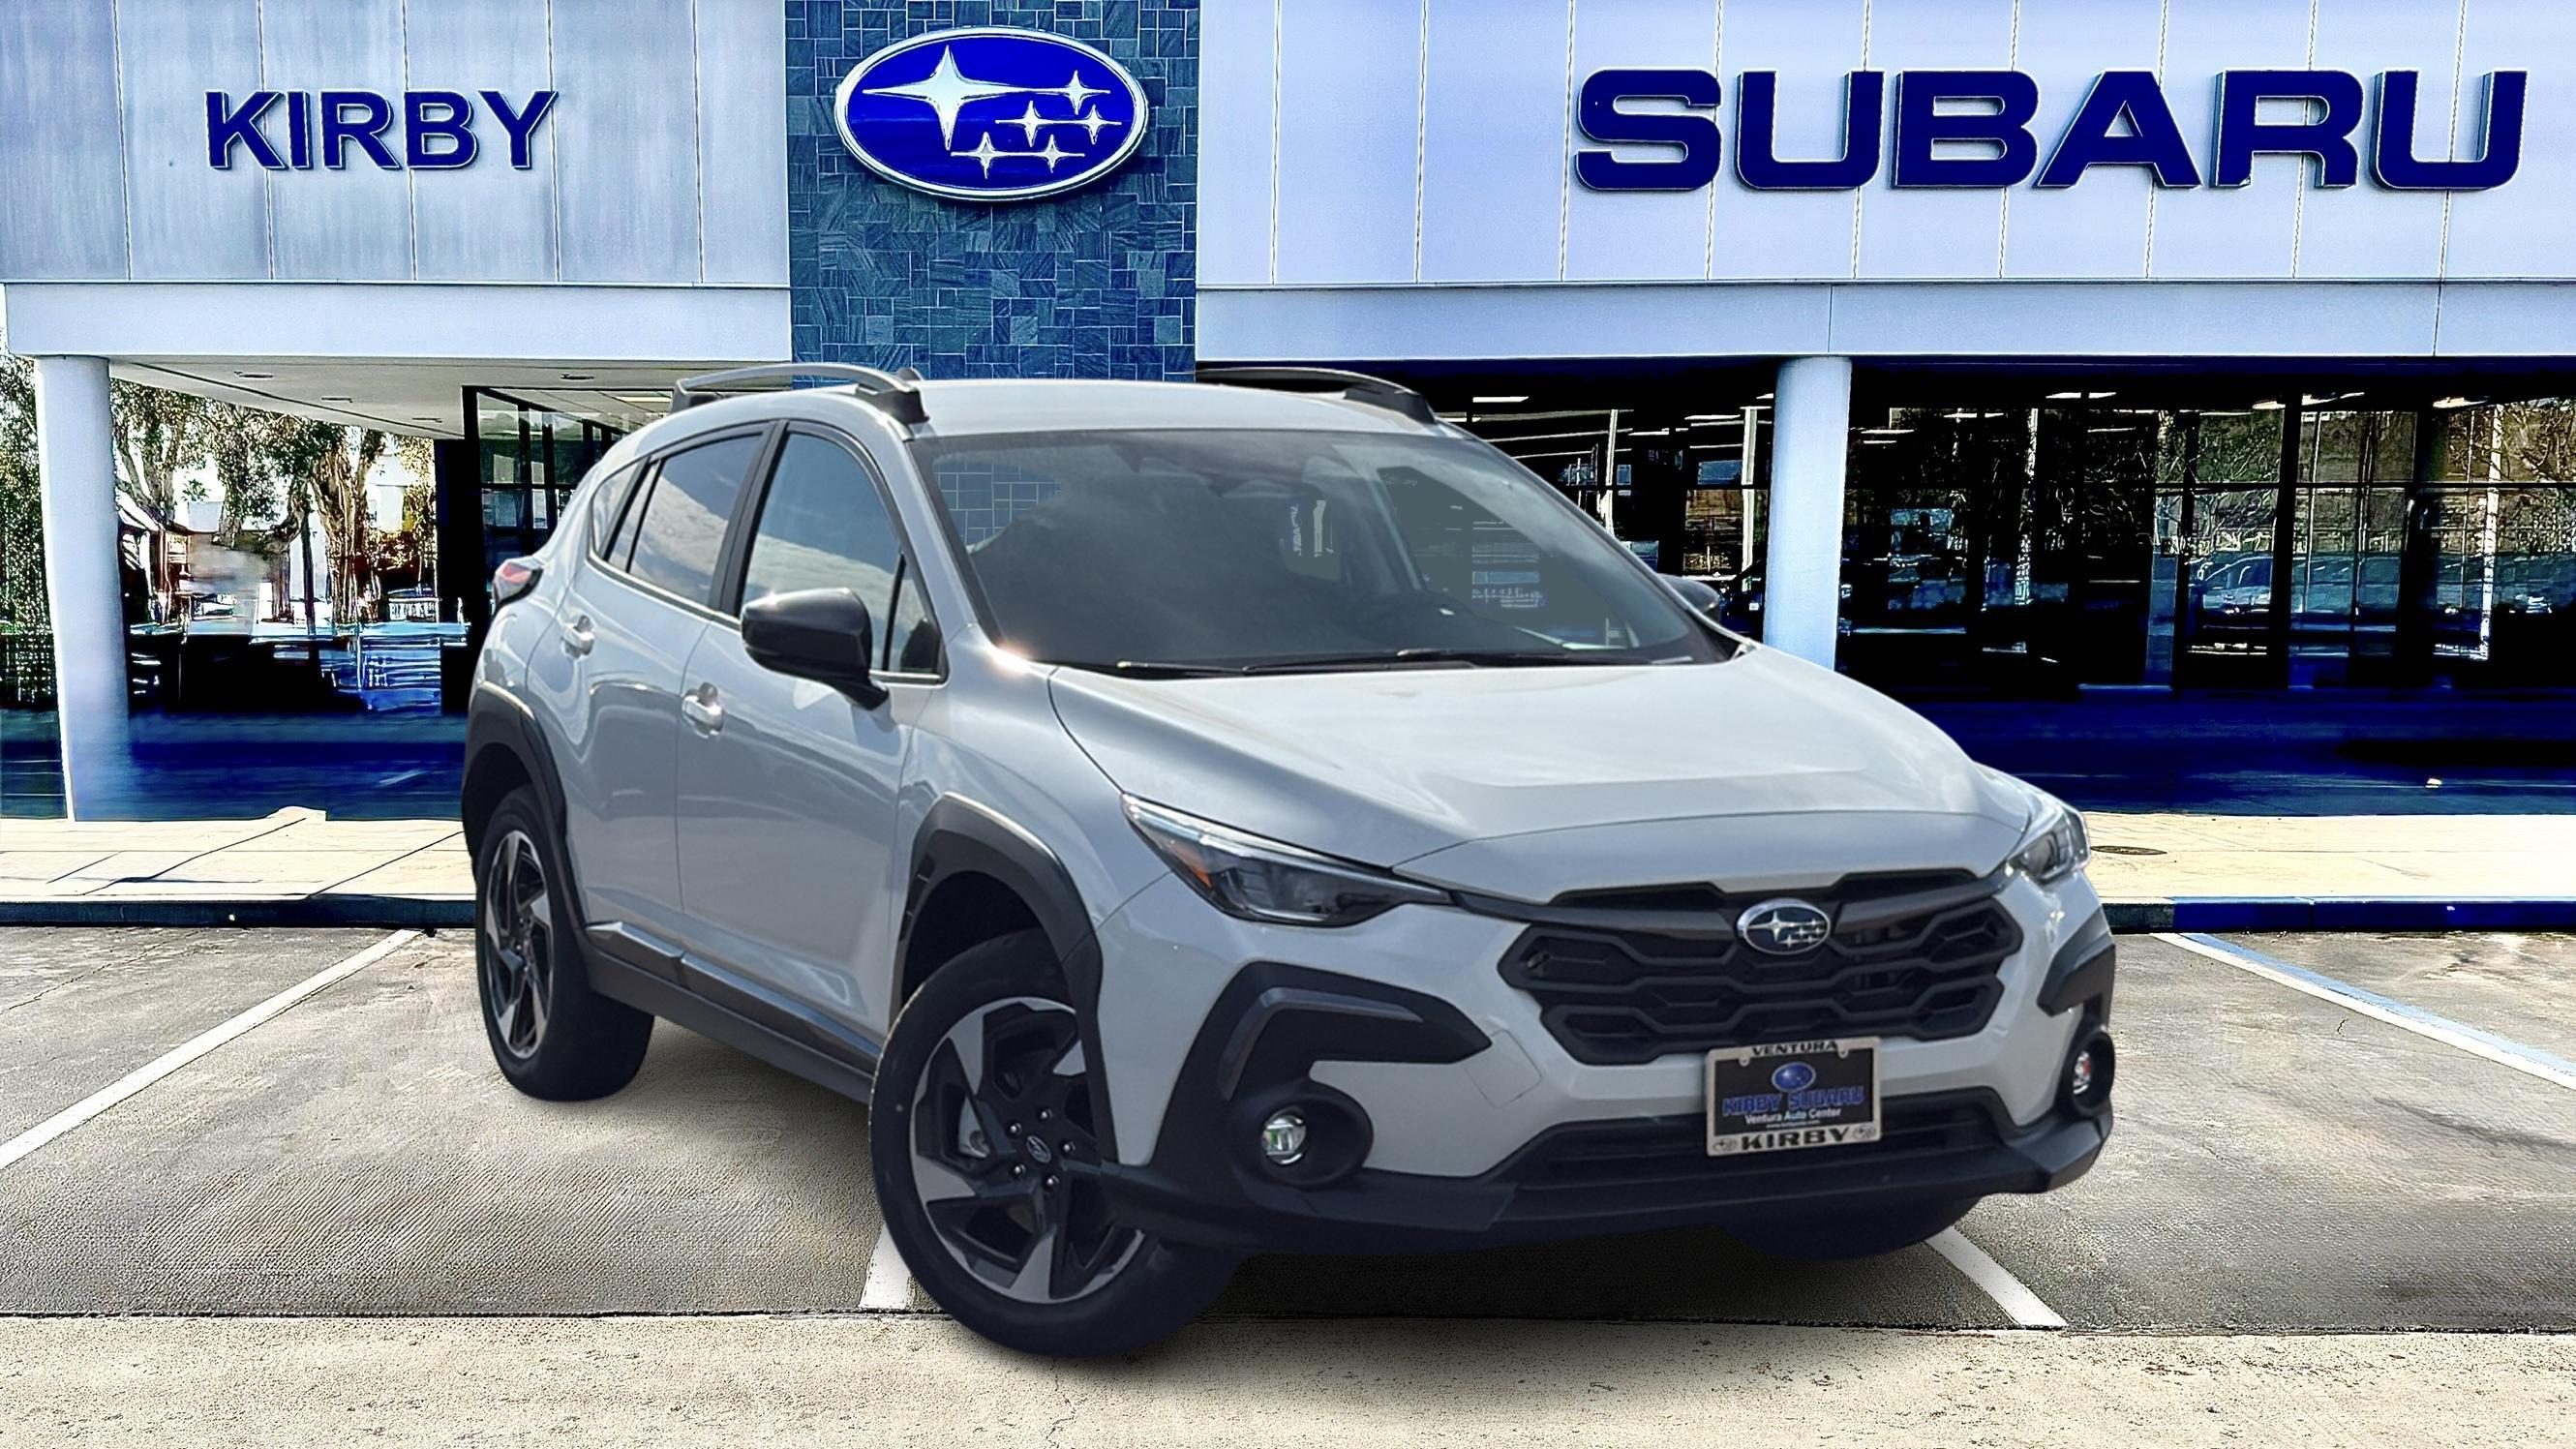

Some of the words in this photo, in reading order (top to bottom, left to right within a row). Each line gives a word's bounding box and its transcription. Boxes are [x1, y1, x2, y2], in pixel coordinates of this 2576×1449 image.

[204, 90, 559, 169] KIRBY
[1575, 68, 2528, 192] SUBARU
[1752, 1041, 1838, 1057] VENTURA
[1723, 1093, 1782, 1117] KIRBY
[1788, 1085, 1864, 1111] SUBARU
[1744, 1113, 1782, 1125] Ventura
[1784, 1110, 1807, 1121] Auto
[1808, 1107, 1842, 1119] Center
[1743, 1126, 1850, 1150] KIRBY
